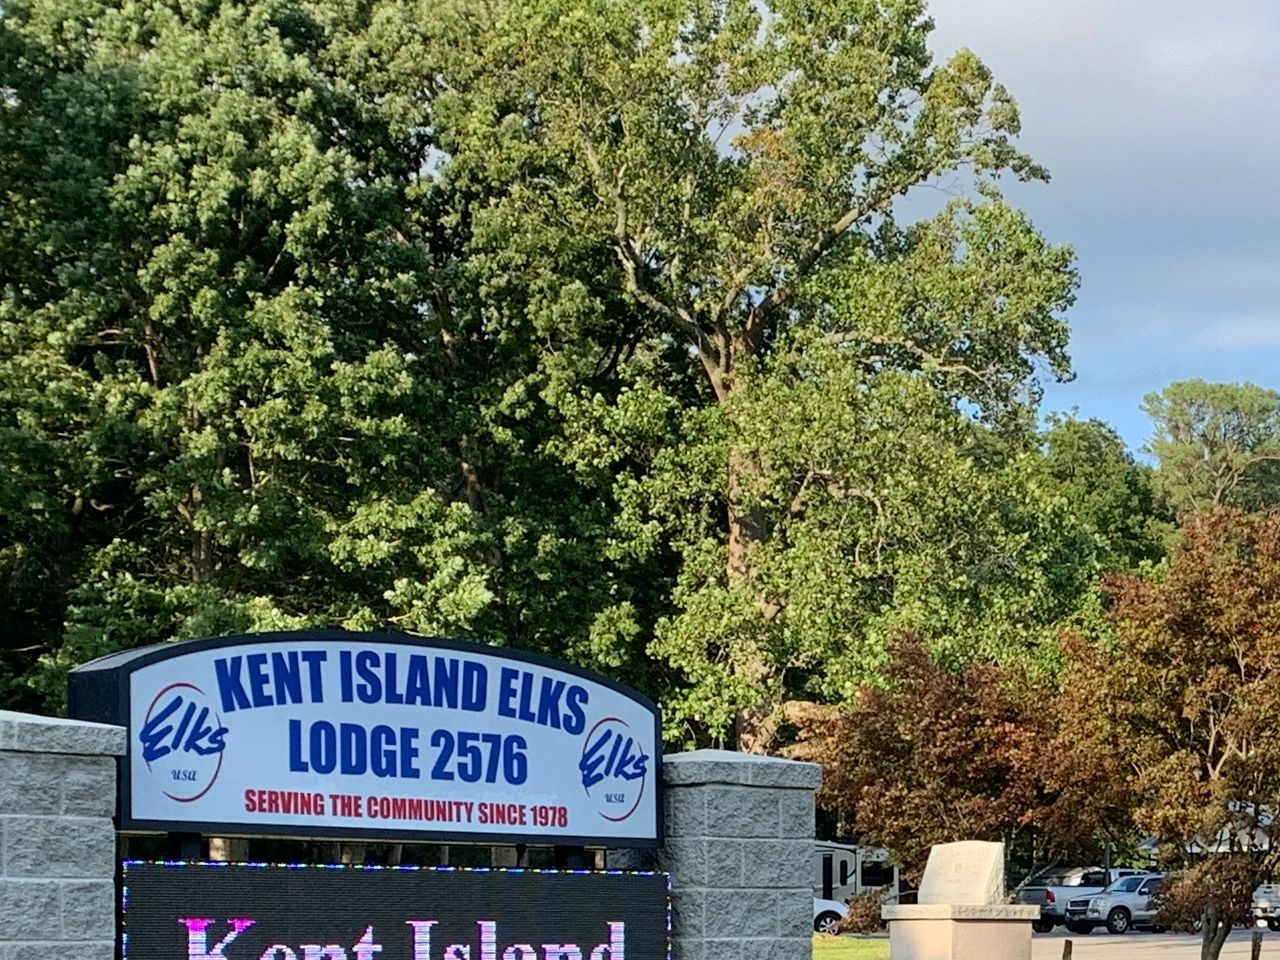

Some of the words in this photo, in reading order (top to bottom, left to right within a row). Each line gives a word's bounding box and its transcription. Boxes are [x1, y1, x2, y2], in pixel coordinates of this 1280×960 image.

[214, 650, 327, 712] KENT
[340, 650, 488, 712] ISLAND
[498, 669, 589, 736] ELKS
[139, 695, 229, 762] Elks
[288, 719, 419, 779] LODGE
[430, 728, 528, 786] 2576
[579, 728, 649, 788] Elks
[171, 769, 197, 782] usa
[245, 788, 325, 816] SERVING
[329, 793, 363, 818] THE
[366, 795, 475, 823] COMMUNITY
[477, 802, 527, 826] SINCE
[530, 804, 568, 828] 1978
